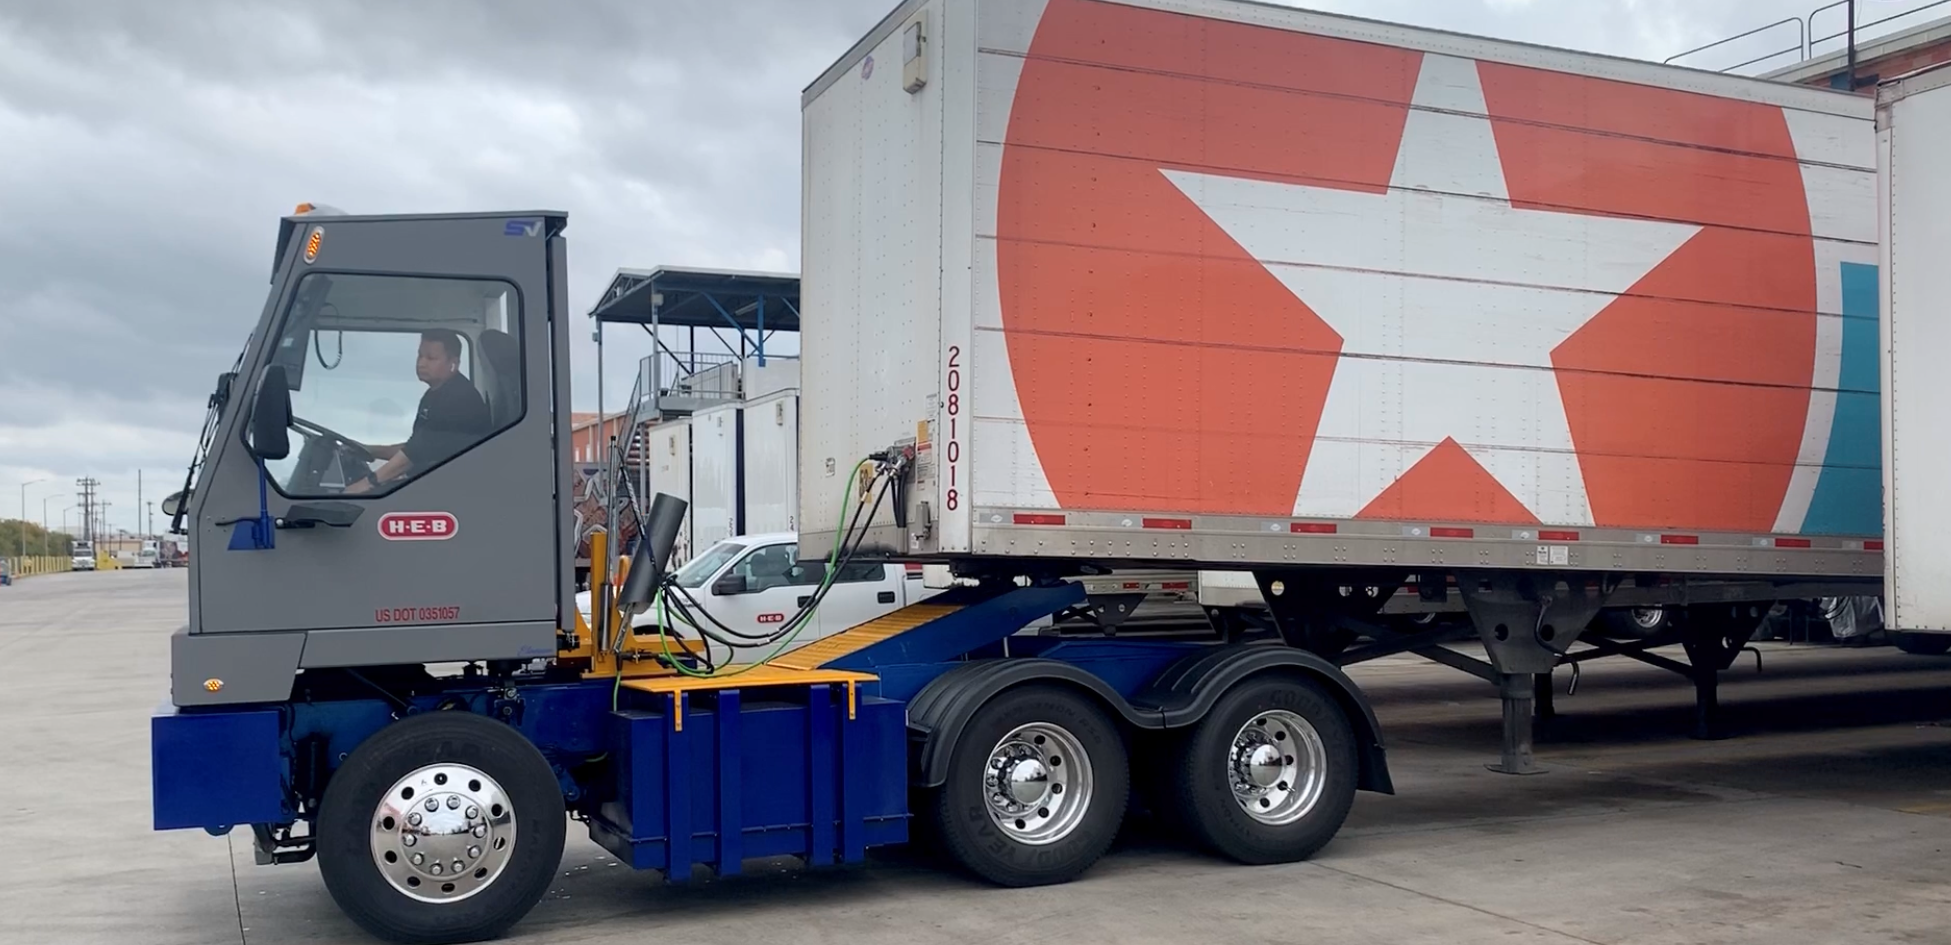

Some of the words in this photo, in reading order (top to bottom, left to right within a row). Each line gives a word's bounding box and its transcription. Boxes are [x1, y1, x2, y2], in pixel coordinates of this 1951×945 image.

[947, 345, 960, 511] 2081018
[375, 608, 391, 622] US
[393, 607, 417, 621] DOT
[419, 606, 460, 620] 0351057
